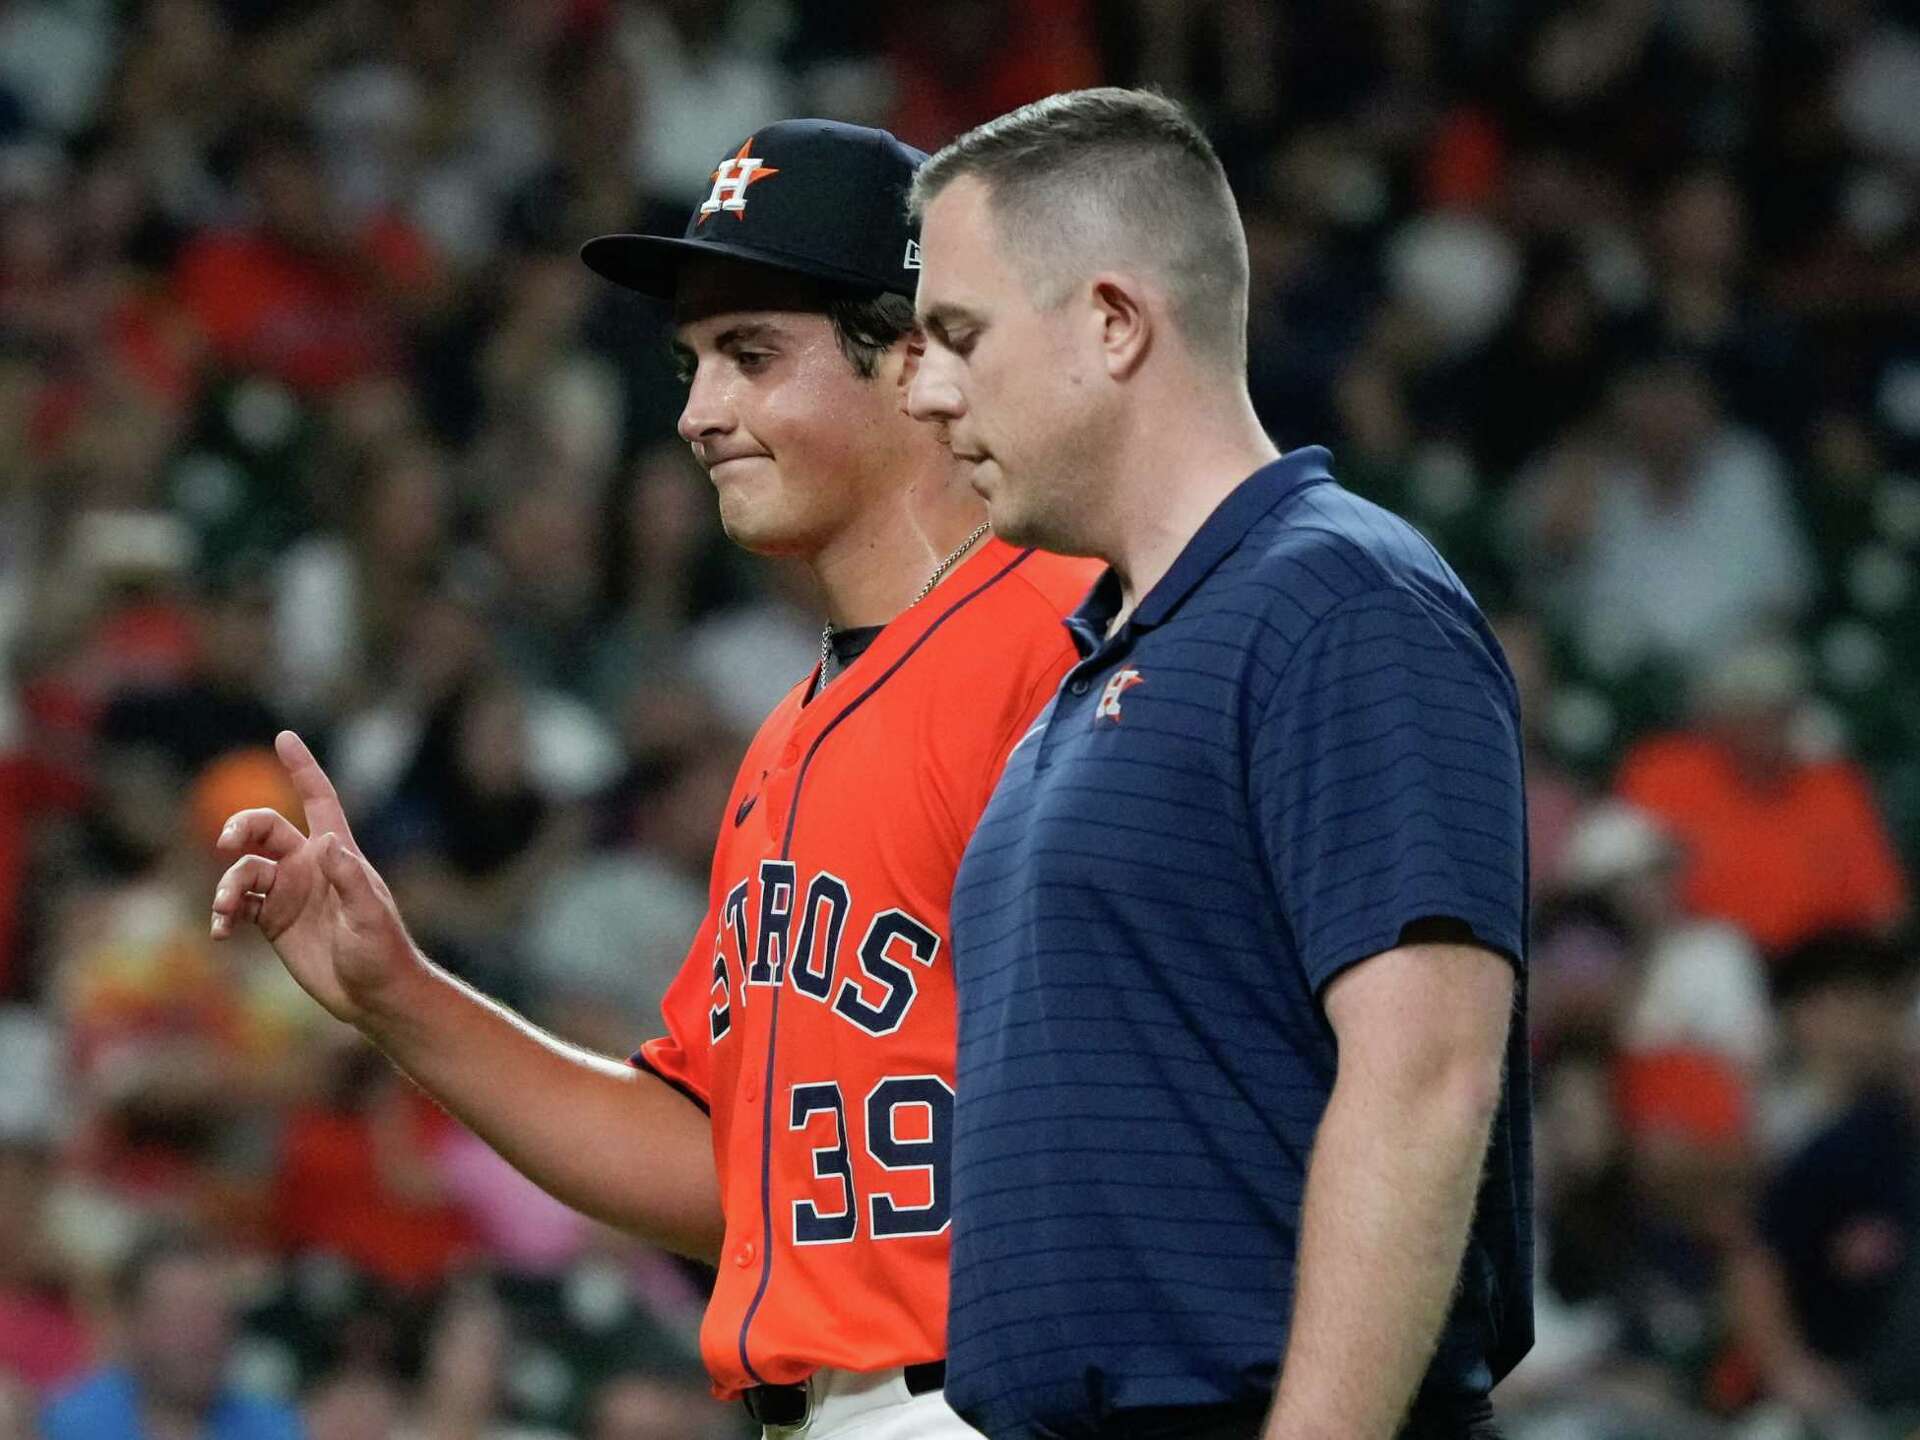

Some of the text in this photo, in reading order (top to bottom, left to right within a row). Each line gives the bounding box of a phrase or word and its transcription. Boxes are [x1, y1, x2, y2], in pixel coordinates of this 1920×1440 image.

[700, 158, 764, 212] H
[1096, 670, 1139, 718] H
[789, 1074, 955, 1246] 39
